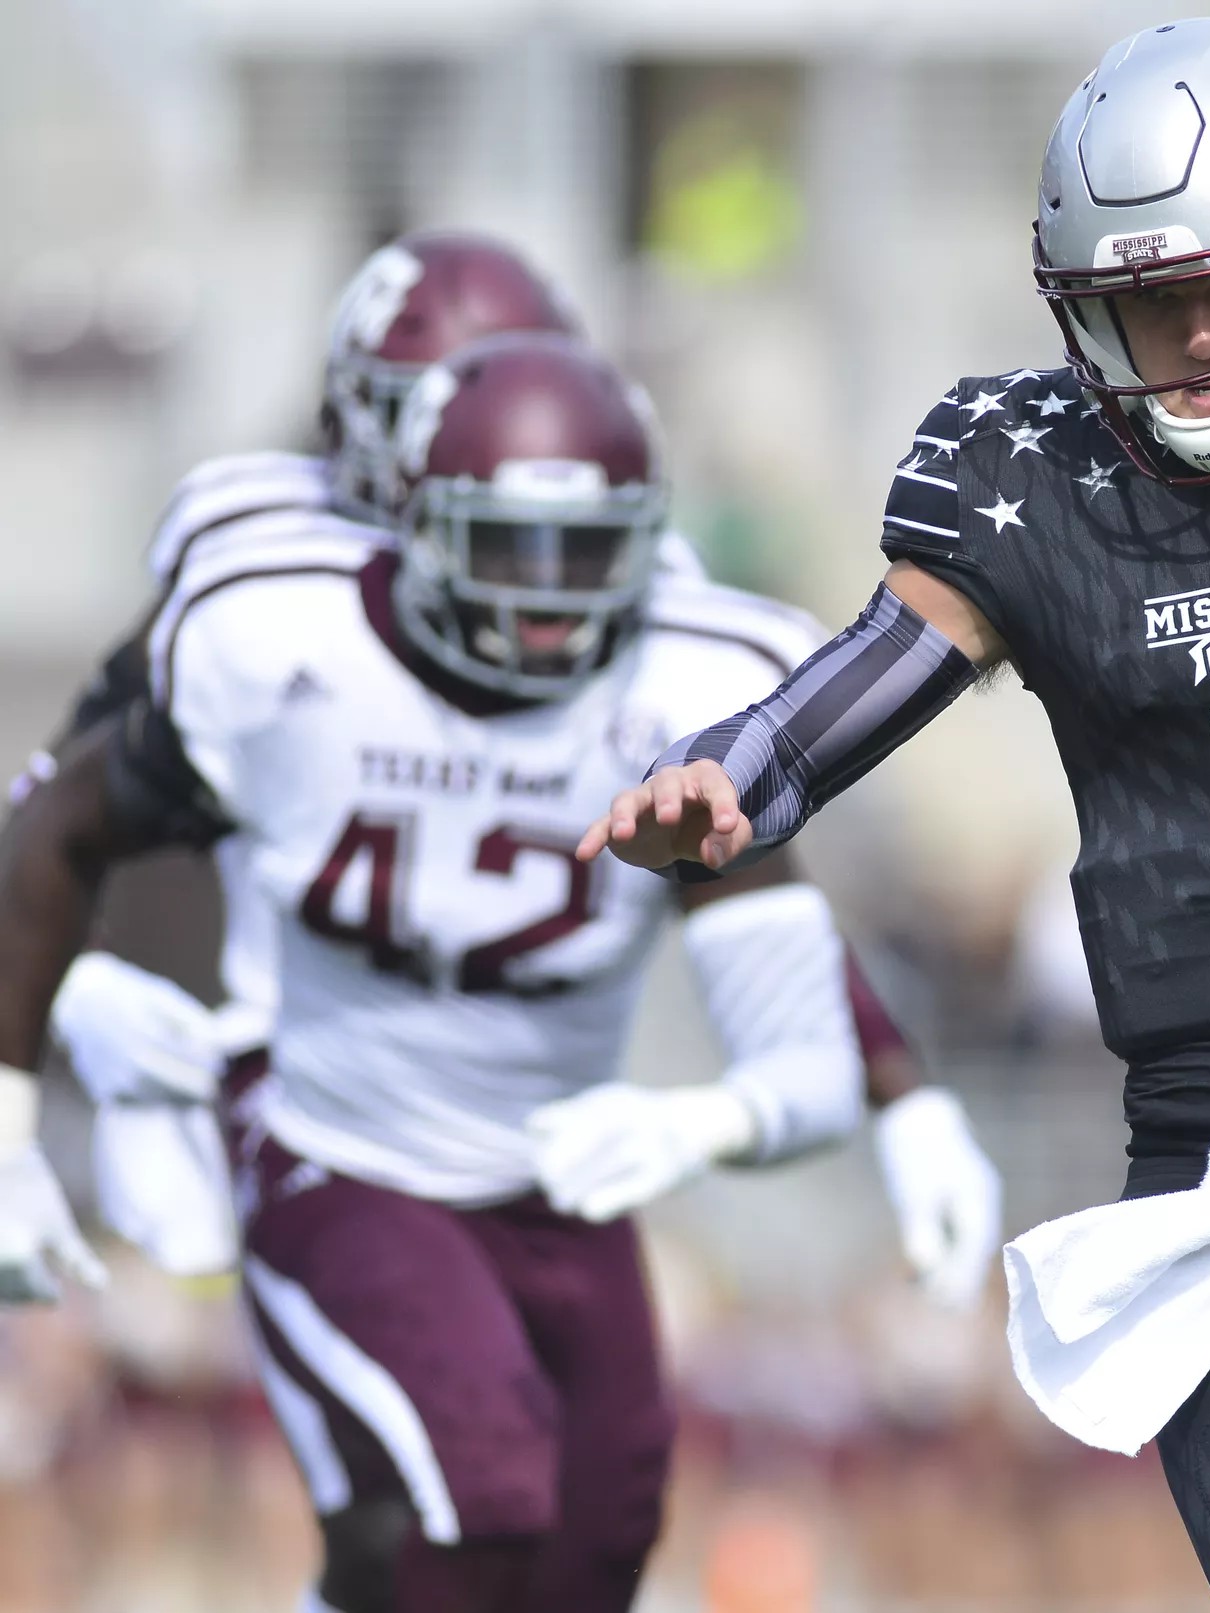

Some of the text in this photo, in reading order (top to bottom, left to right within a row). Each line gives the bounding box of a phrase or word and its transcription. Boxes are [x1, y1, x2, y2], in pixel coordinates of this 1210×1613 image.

[1112, 235, 1167, 251] MISSISSIPPI
[1127, 249, 1154, 261] STATE
[301, 808, 600, 992] 42
